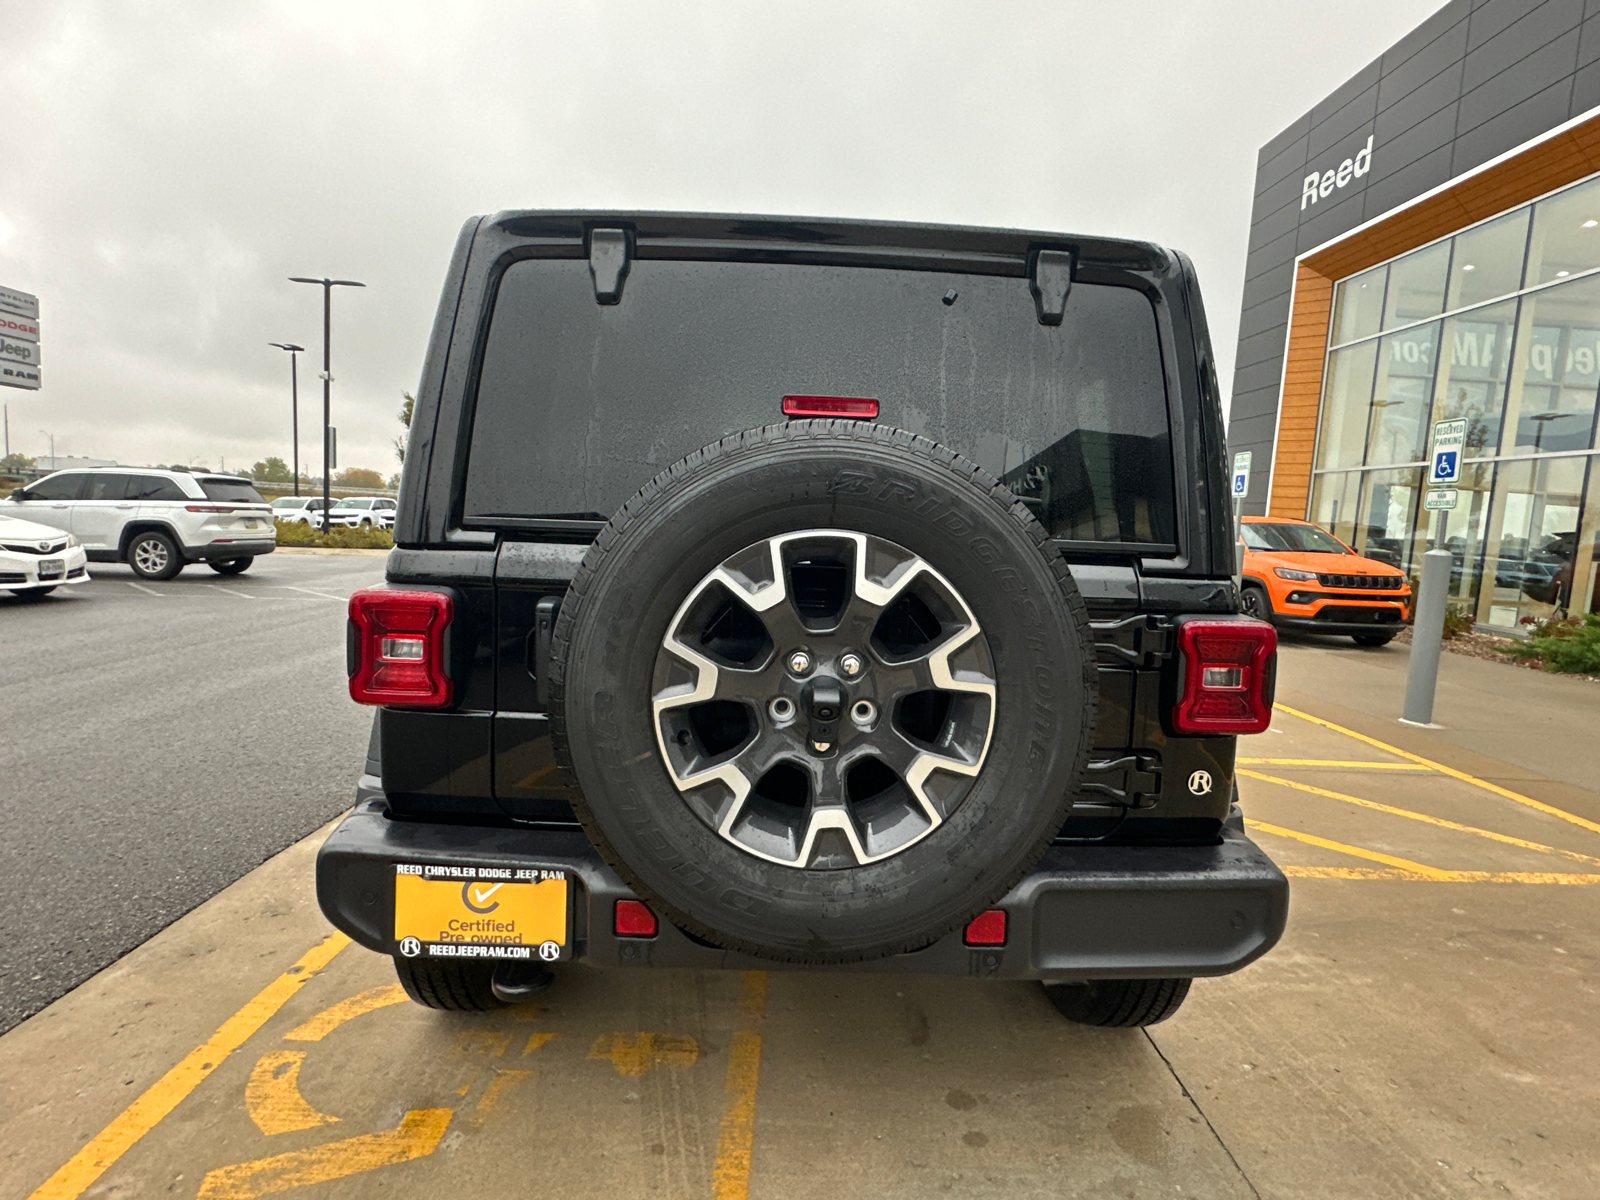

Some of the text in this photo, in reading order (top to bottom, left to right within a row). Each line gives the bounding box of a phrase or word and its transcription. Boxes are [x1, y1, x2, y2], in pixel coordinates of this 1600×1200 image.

[1301, 134, 1374, 211] Reed
[0, 292, 35, 306] RYSLER
[0, 318, 36, 334] ODGE
[4, 368, 39, 381] RAM
[1436, 424, 1463, 436] RESERVED
[1435, 436, 1462, 446] PARKING
[397, 864, 565, 881] REED CHRYSLER DODGE JEEP RAM
[448, 918, 515, 933] Certified
[439, 930, 522, 944] Pre-owned
[429, 944, 530, 959] REEDJEEPRAM.COM
